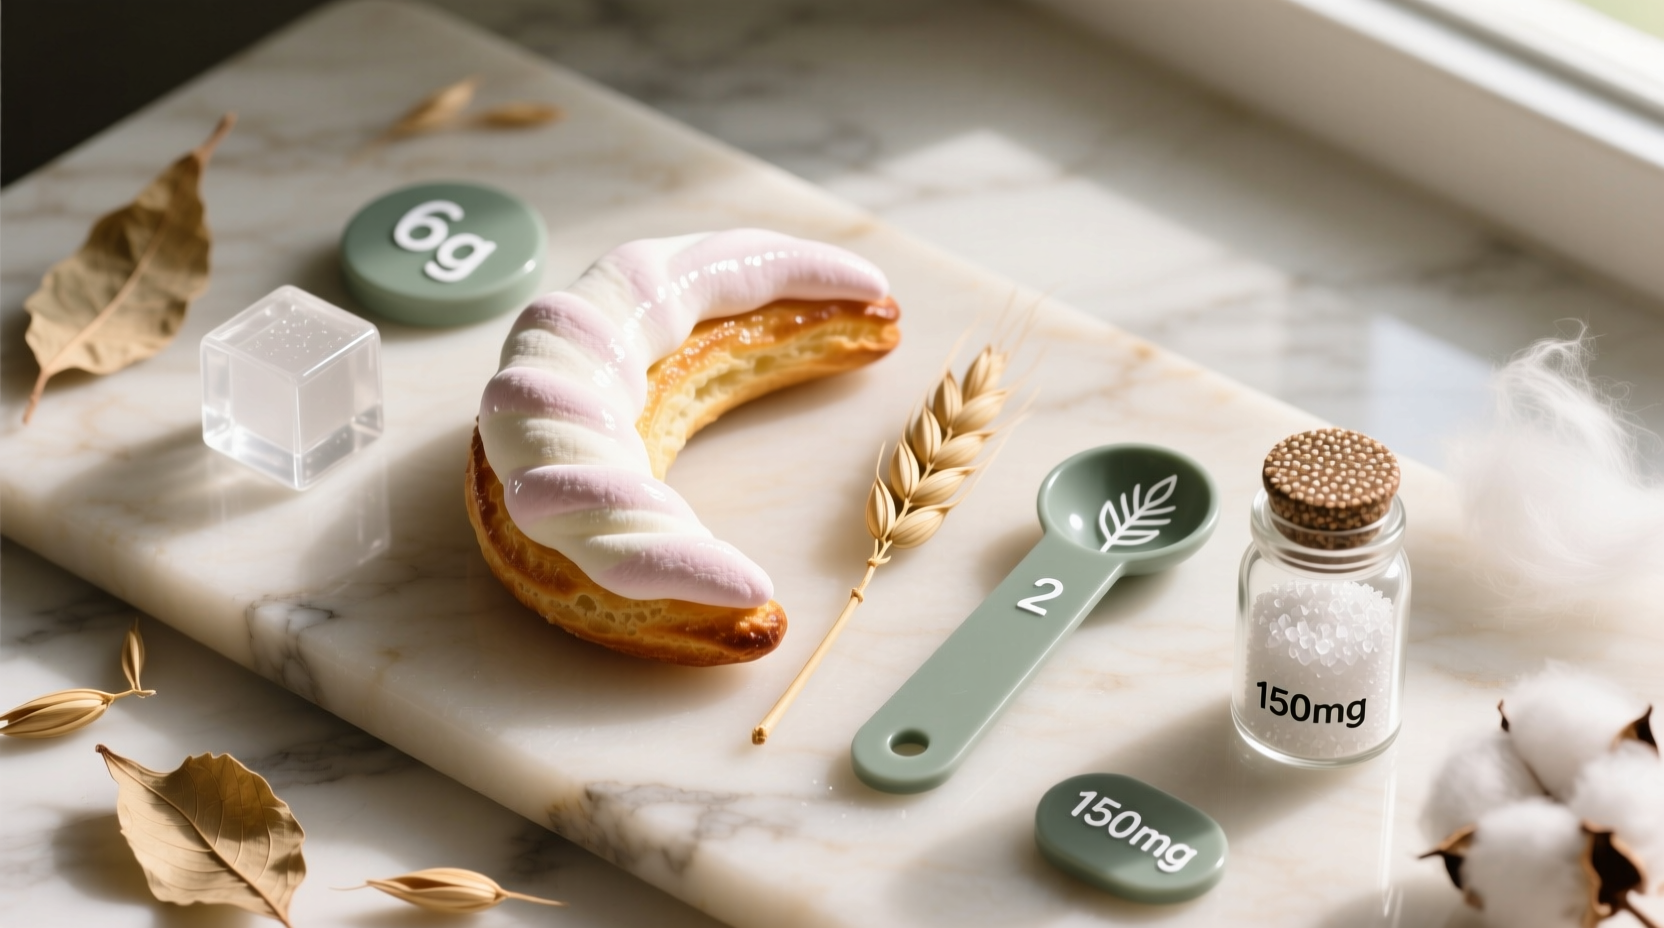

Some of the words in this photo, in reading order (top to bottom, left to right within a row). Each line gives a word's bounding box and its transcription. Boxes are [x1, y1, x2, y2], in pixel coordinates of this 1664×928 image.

[394, 200, 497, 283] 6g
[1017, 578, 1064, 616] 2
[1257, 681, 1367, 729] 150mg
[1071, 791, 1198, 873] 150mg
